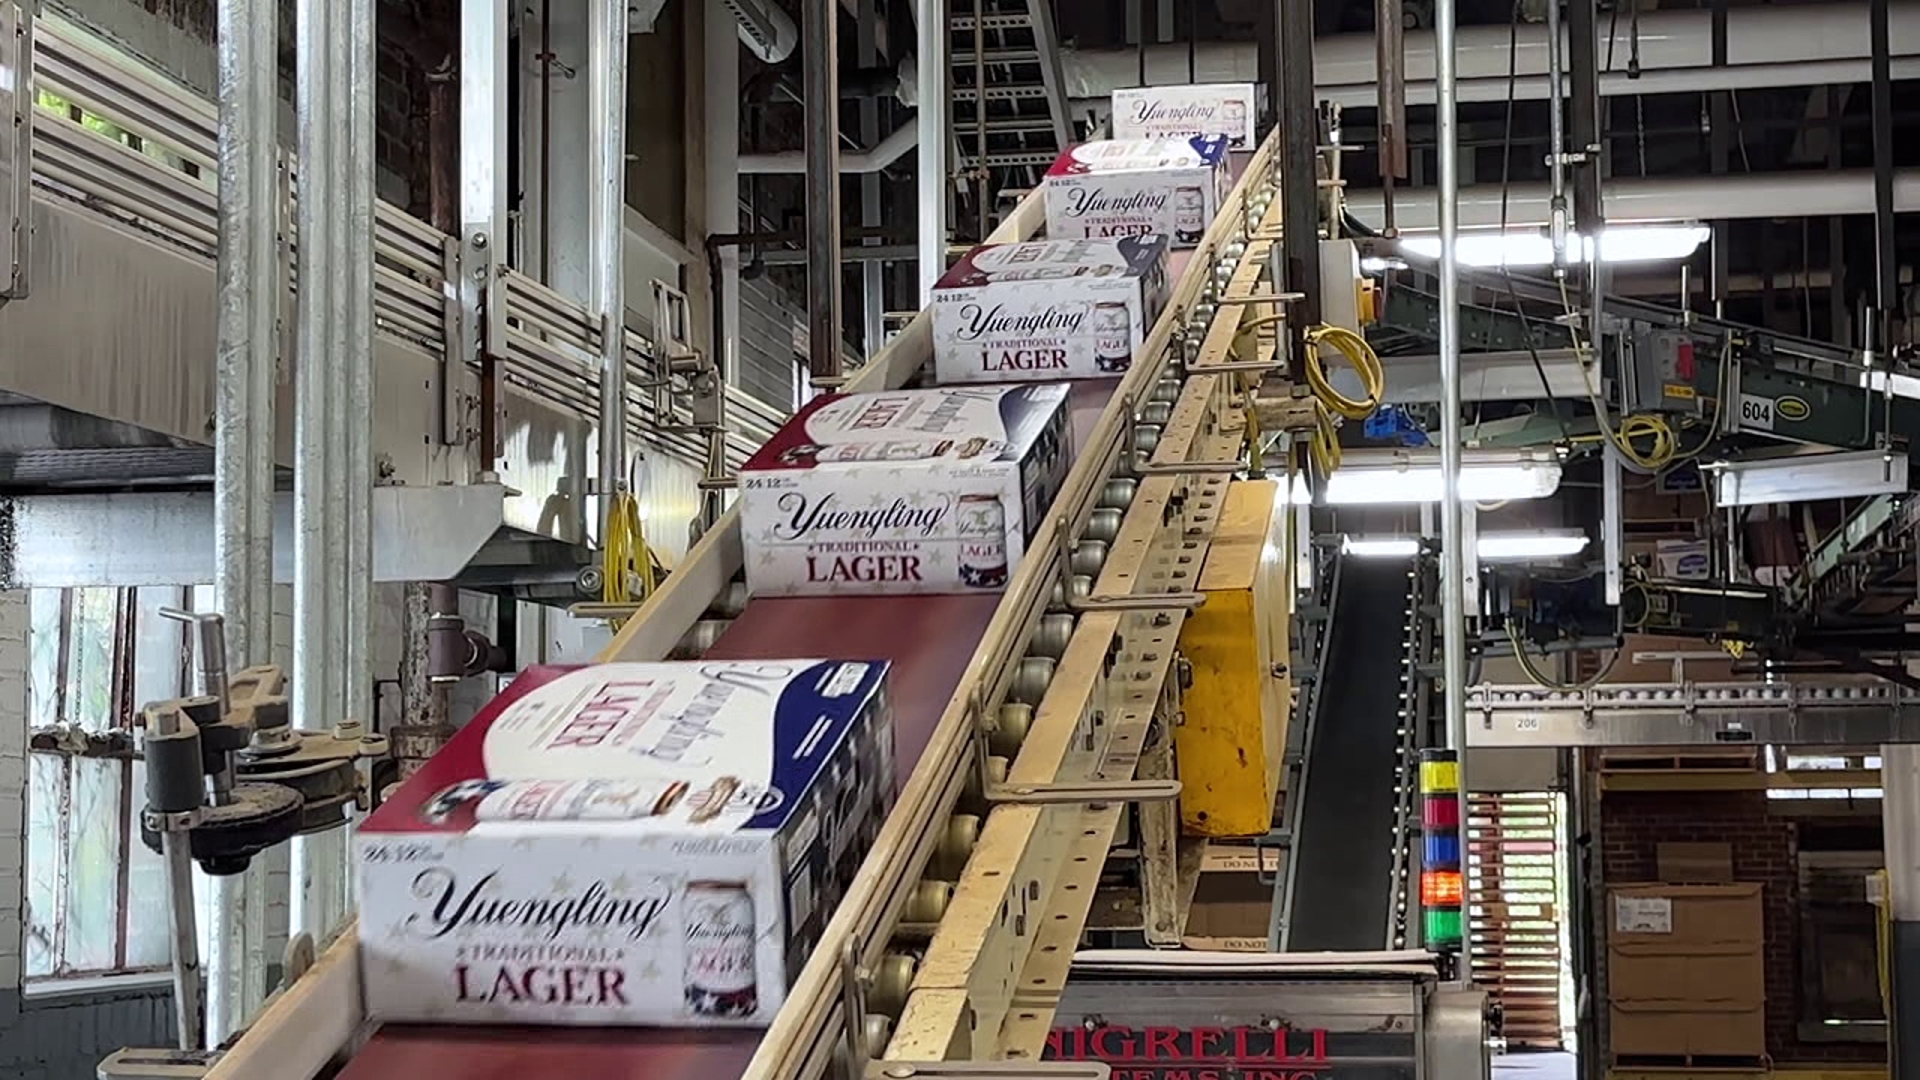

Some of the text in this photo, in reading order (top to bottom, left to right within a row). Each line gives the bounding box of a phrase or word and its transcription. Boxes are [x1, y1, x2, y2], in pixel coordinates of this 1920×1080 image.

[1130, 99, 1220, 125] Yuengling
[1066, 186, 1171, 218] Yuengling
[1090, 216, 1146, 224] TRADITIONAL
[1084, 225, 1153, 239] LAGER
[956, 302, 1090, 341] Yuengling
[989, 338, 1060, 349] TRADITIONAL
[982, 349, 1068, 372] LAGER
[1742, 401, 1770, 422] 604
[746, 477, 762, 489] 24
[767, 477, 780, 488] 12
[774, 491, 950, 541] Yuengling
[817, 540, 912, 553] TRADITIONAL
[807, 556, 923, 583] LAGER
[1517, 719, 1537, 728] 206
[404, 866, 673, 942] Yuengling
[455, 963, 629, 1005] LAGER
